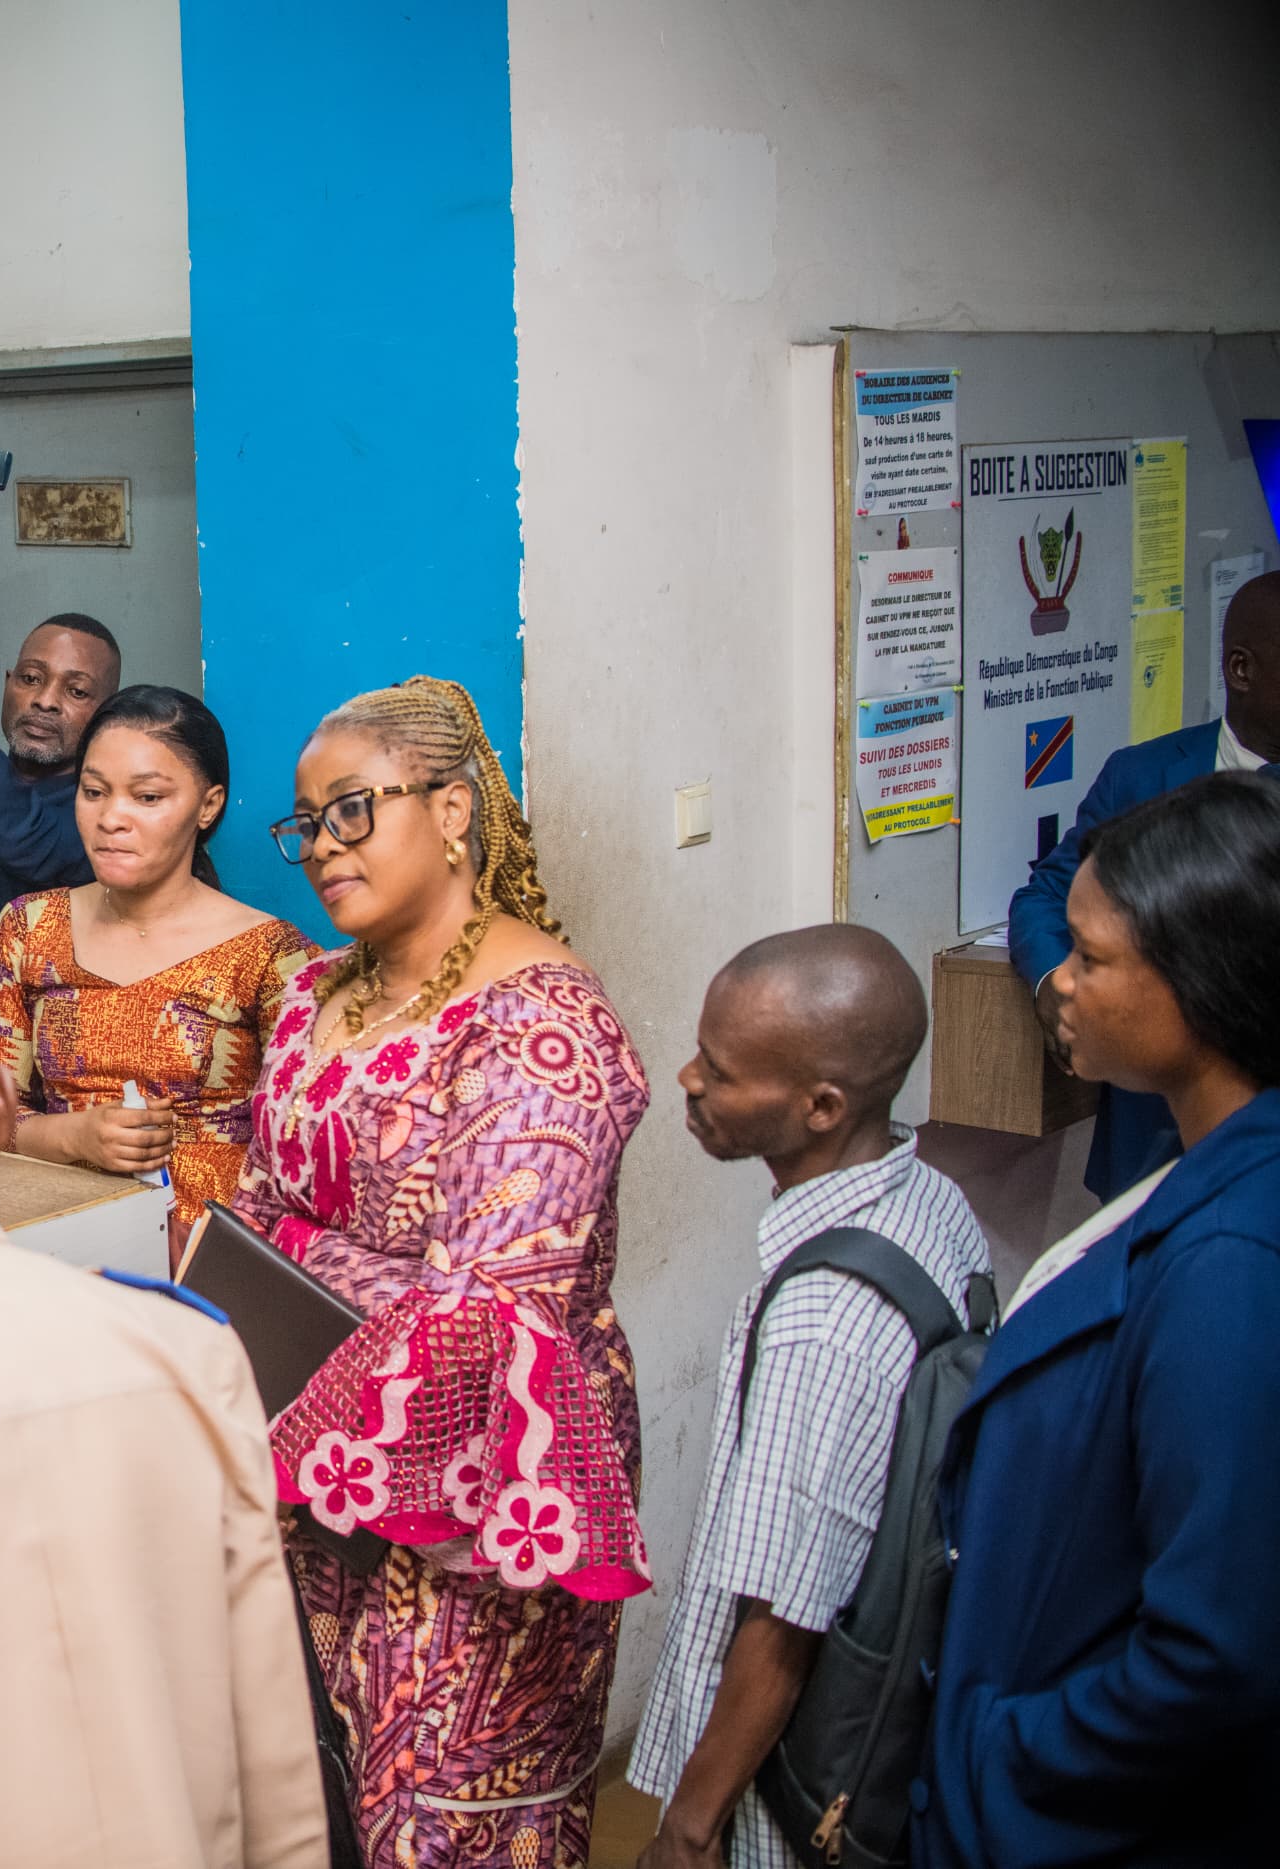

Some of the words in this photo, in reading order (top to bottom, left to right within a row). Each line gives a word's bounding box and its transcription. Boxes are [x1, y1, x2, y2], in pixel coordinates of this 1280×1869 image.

[864, 378, 895, 388] HORAIRE
[897, 376, 910, 386] DES
[911, 374, 950, 385] AUDIENCES
[862, 395, 872, 405] DU
[873, 393, 911, 404] DIRECTEUR
[912, 392, 922, 402] DE
[923, 390, 954, 401] CABINET
[874, 415, 894, 426] TOUS
[897, 413, 910, 424] LES
[912, 411, 940, 422] MARDIS
[864, 437, 872, 448] De
[874, 436, 883, 446] 14
[885, 435, 908, 445] heures
[865, 456, 877, 465] sauf
[878, 454, 909, 466] production
[910, 452, 926, 461] d'une
[928, 450, 944, 459] carte
[946, 449, 952, 458] de
[871, 471, 886, 480] visite
[888, 470, 904, 480] ayant
[905, 468, 919, 477] date
[971, 456, 1014, 496] BOITE
[1021, 455, 1030, 492] A
[1035, 450, 1127, 491] SUGGESTION
[897, 499, 928, 508] PROTOCOLE
[888, 569, 934, 583] COMMUNIQUE
[871, 596, 902, 607] DESORMAIS
[903, 596, 910, 604] LE
[912, 592, 942, 602] DIRECTEUR
[944, 591, 952, 599] DE
[866, 615, 889, 624] CABINET
[899, 611, 911, 620] VPM
[912, 610, 920, 618] NE
[944, 607, 955, 616] QUE
[867, 632, 879, 641] SUR
[875, 649, 881, 657] LA
[882, 648, 891, 656] FIN
[892, 646, 898, 654] DE
[900, 645, 908, 653] LA
[910, 640, 946, 652] MANDATURE
[980, 656, 1024, 682] République
[1026, 648, 1081, 672] Démocratique
[1083, 643, 1092, 662] du
[1094, 642, 1118, 662] Congo
[984, 688, 1022, 710] Ministère
[1024, 682, 1034, 702] de
[1037, 680, 1044, 700] la
[1046, 678, 1079, 698] Fonction
[1081, 671, 1113, 692] Publique
[884, 701, 912, 715] CABINET
[914, 698, 924, 710] DU
[874, 717, 911, 734] FONCTION
[912, 711, 944, 727] PUBLIQUE
[860, 748, 886, 765] SUIVI
[888, 745, 905, 760] DES
[907, 737, 950, 756] DOSSIERS
[878, 767, 897, 780] TOUS
[898, 762, 912, 775] LES
[914, 759, 942, 772] LUNDIS
[881, 786, 890, 798] ET
[893, 778, 936, 794] MERCREDIS
[884, 824, 892, 832] AU
[893, 816, 930, 830] PROTOCOLE
